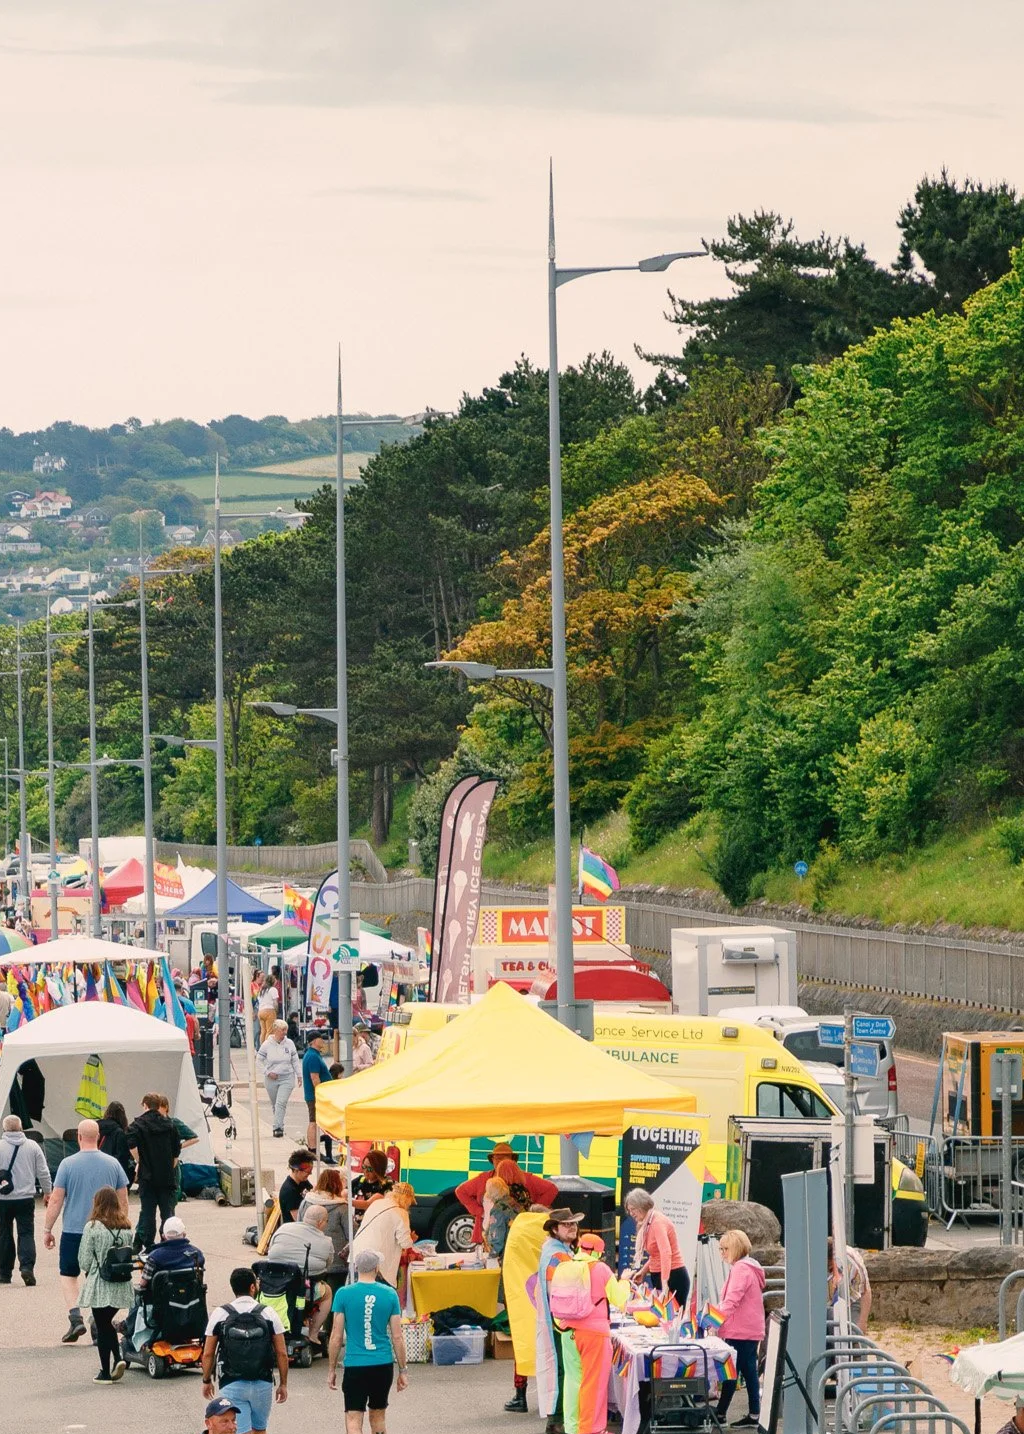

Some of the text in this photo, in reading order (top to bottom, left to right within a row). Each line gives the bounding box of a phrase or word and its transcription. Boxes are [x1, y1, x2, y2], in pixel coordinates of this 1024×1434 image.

[501, 961, 524, 971] TEA
[527, 961, 535, 971] &
[632, 1026, 679, 1039] Service
[682, 1028, 704, 1040] Ltd
[606, 1050, 679, 1063] BULANCE
[631, 1125, 701, 1145] TOGETHER
[364, 1294, 376, 1350] Stonewall
